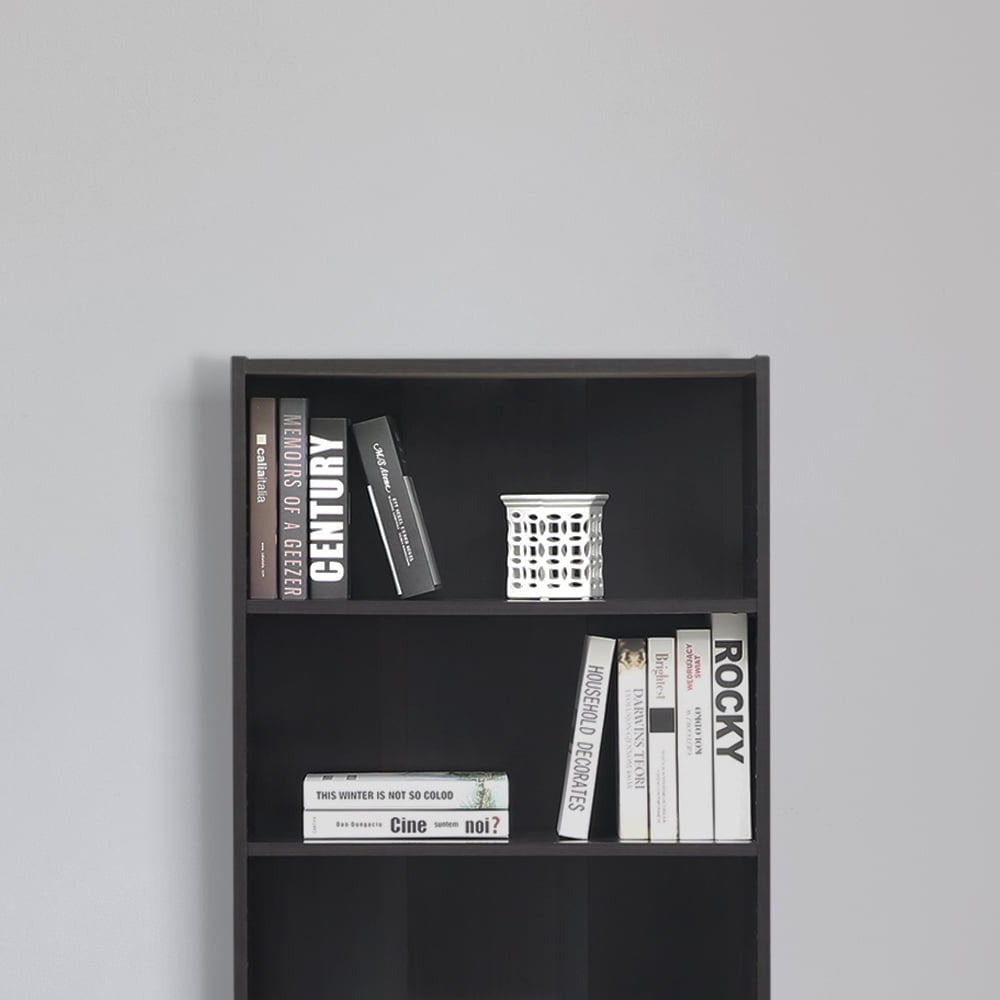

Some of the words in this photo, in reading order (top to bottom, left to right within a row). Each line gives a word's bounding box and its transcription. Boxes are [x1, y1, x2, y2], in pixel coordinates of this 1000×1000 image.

[256, 447, 268, 504] caliaitalia
[282, 413, 303, 489] MEMOIRS
[283, 497, 302, 515] OF
[283, 521, 302, 531] A
[309, 434, 345, 583] CENTURY
[283, 538, 303, 597] GEEZER
[579, 664, 605, 736] HOUSEHOLD
[652, 652, 670, 700] Brightest
[714, 639, 745, 765] ROCKY
[632, 687, 645, 748] DARWINS
[316, 790, 337, 801] THIS
[339, 790, 374, 801] WINTER
[376, 790, 386, 801] IS
[388, 790, 406, 801] NOT
[409, 790, 422, 801] SO
[424, 790, 454, 801] COLOD
[568, 741, 594, 813] DECORATES
[633, 751, 646, 790] TEORI
[390, 816, 427, 834] Cine
[465, 816, 500, 834] noi?
